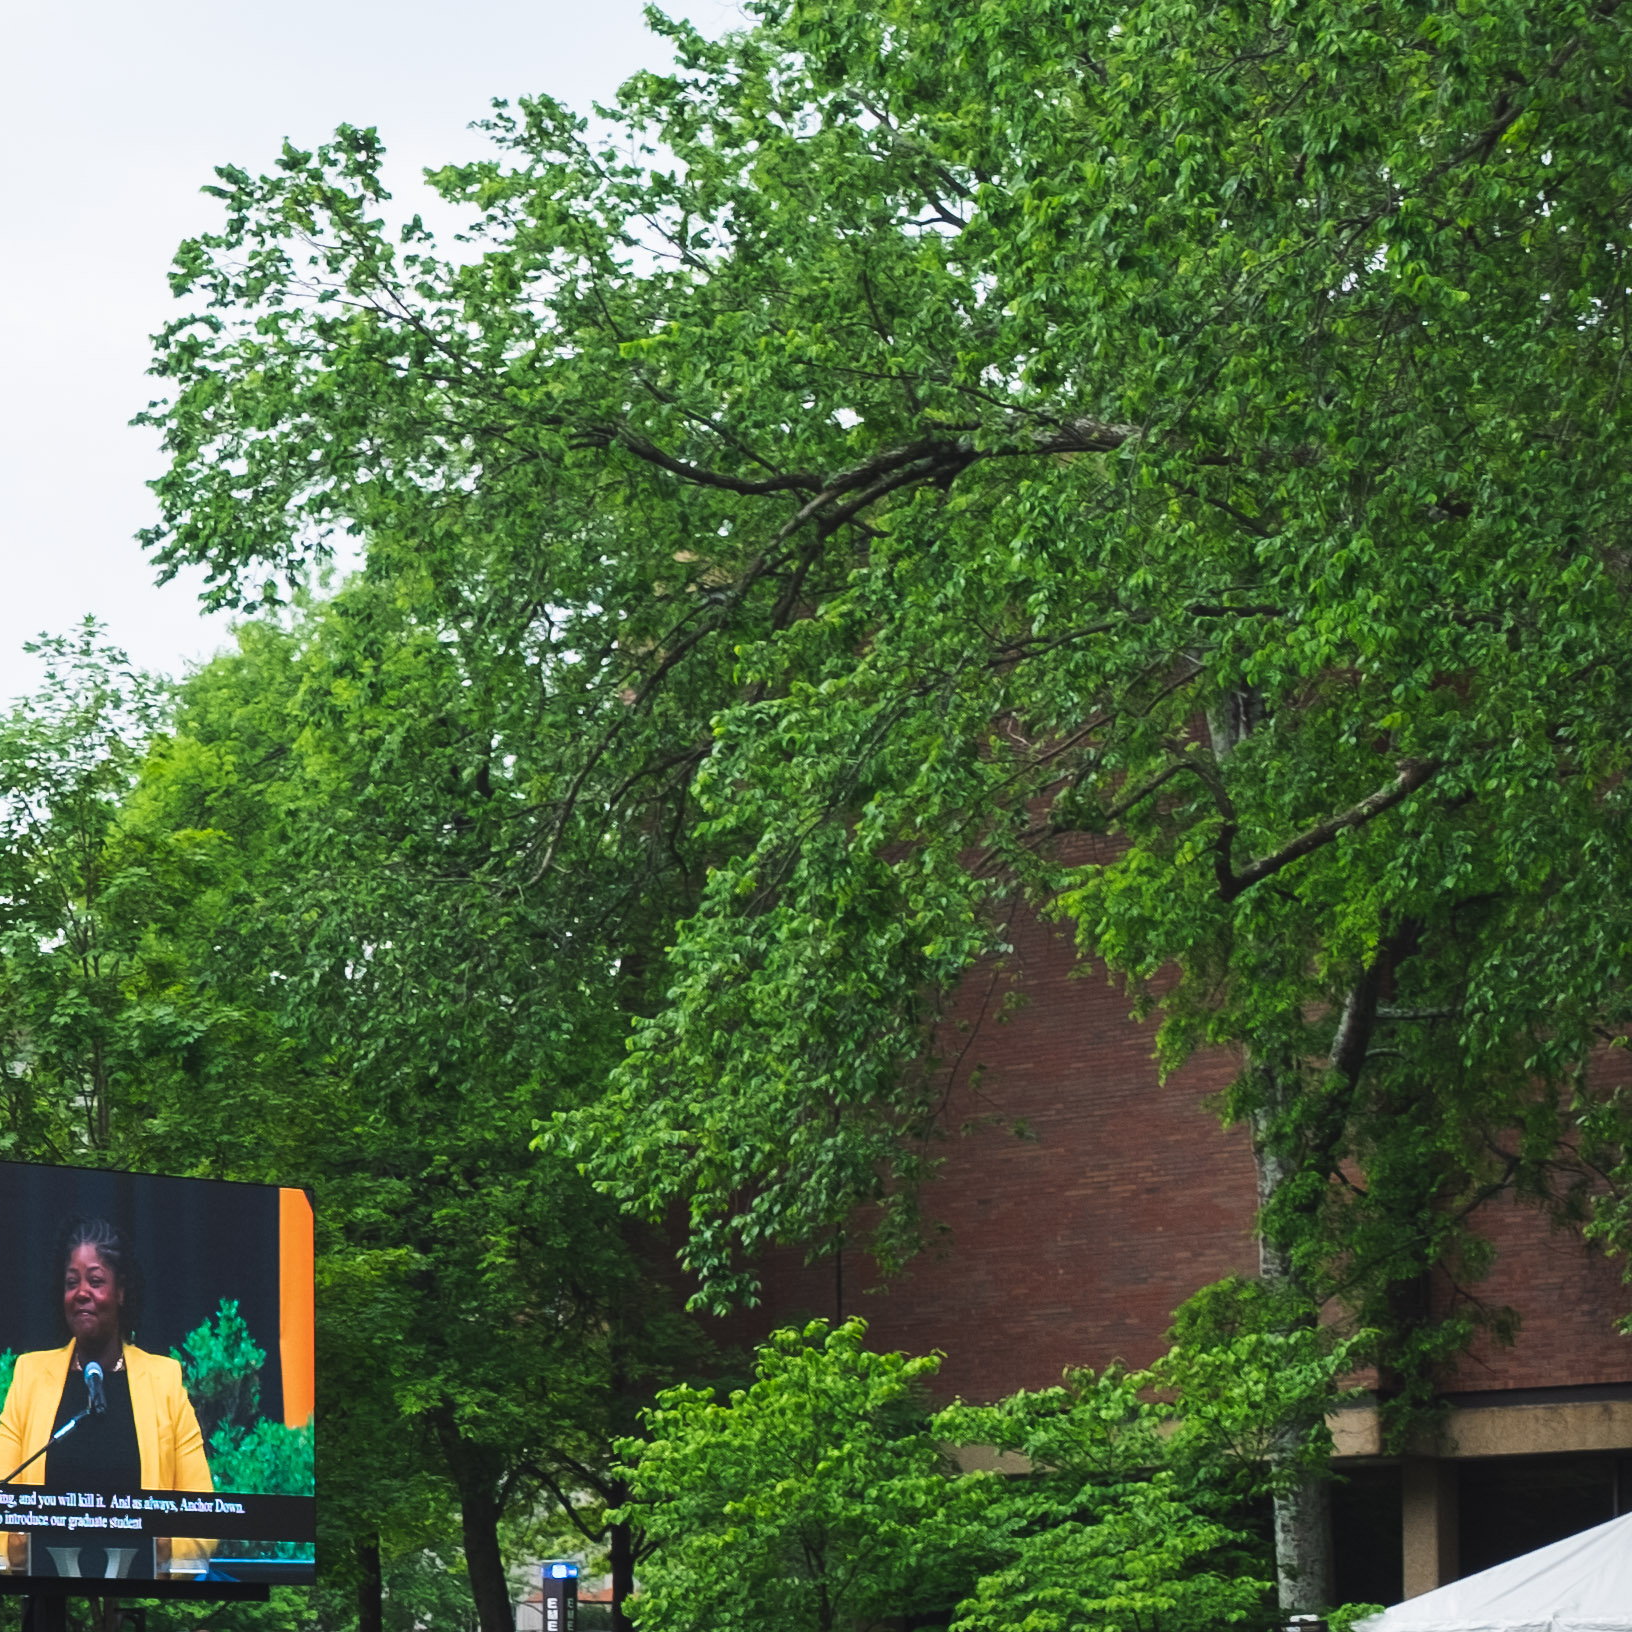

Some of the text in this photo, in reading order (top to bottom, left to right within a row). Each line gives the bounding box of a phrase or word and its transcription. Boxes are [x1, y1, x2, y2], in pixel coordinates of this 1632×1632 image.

[19, 1491, 36, 1505] and
[38, 1495, 56, 1509] you
[58, 1493, 77, 1506] will
[78, 1493, 94, 1507] kill
[96, 1494, 106, 1508] it.
[110, 1494, 131, 1509] And
[132, 1499, 142, 1509] as
[143, 1496, 178, 1513] always,
[180, 1498, 214, 1512] Anchor
[215, 1499, 245, 1513] Down.
[4, 1510, 49, 1526] introduce
[50, 1516, 67, 1526] our
[68, 1513, 107, 1530] graduate
[109, 1514, 142, 1529] student
